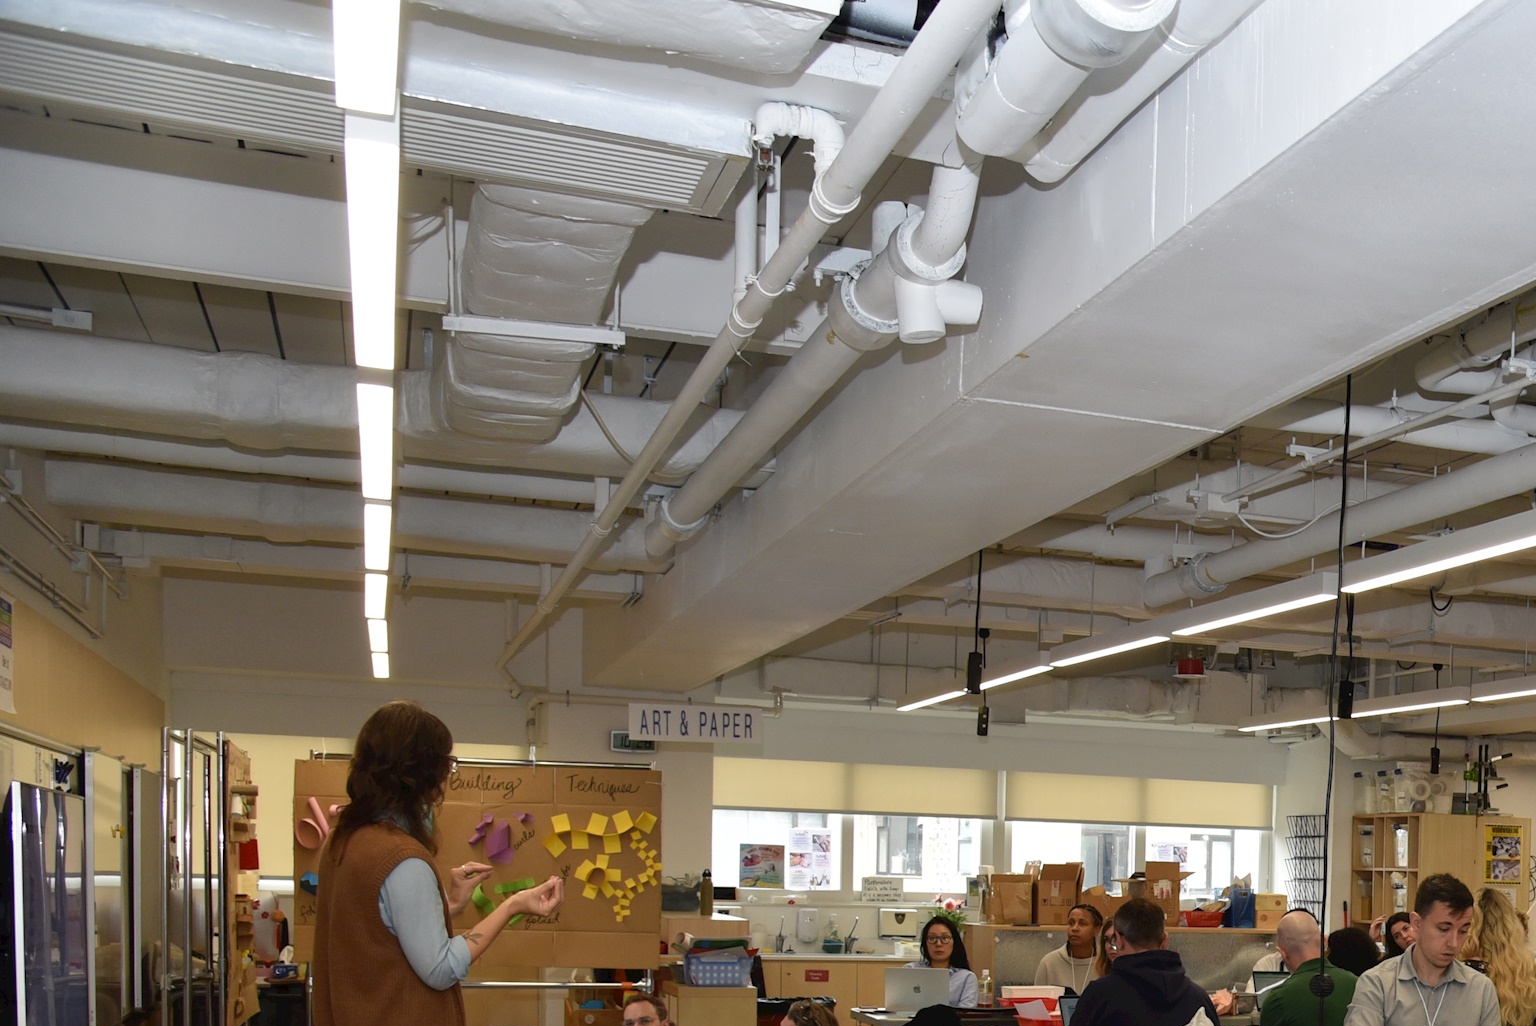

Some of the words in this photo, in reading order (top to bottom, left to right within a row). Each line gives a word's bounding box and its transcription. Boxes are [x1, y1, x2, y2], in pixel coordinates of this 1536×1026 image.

[640, 709, 671, 736] ART
[680, 710, 689, 736] &
[699, 711, 753, 739] PAPER
[449, 771, 523, 800] Building
[566, 774, 640, 802] Techniques
[525, 912, 560, 930] folded
